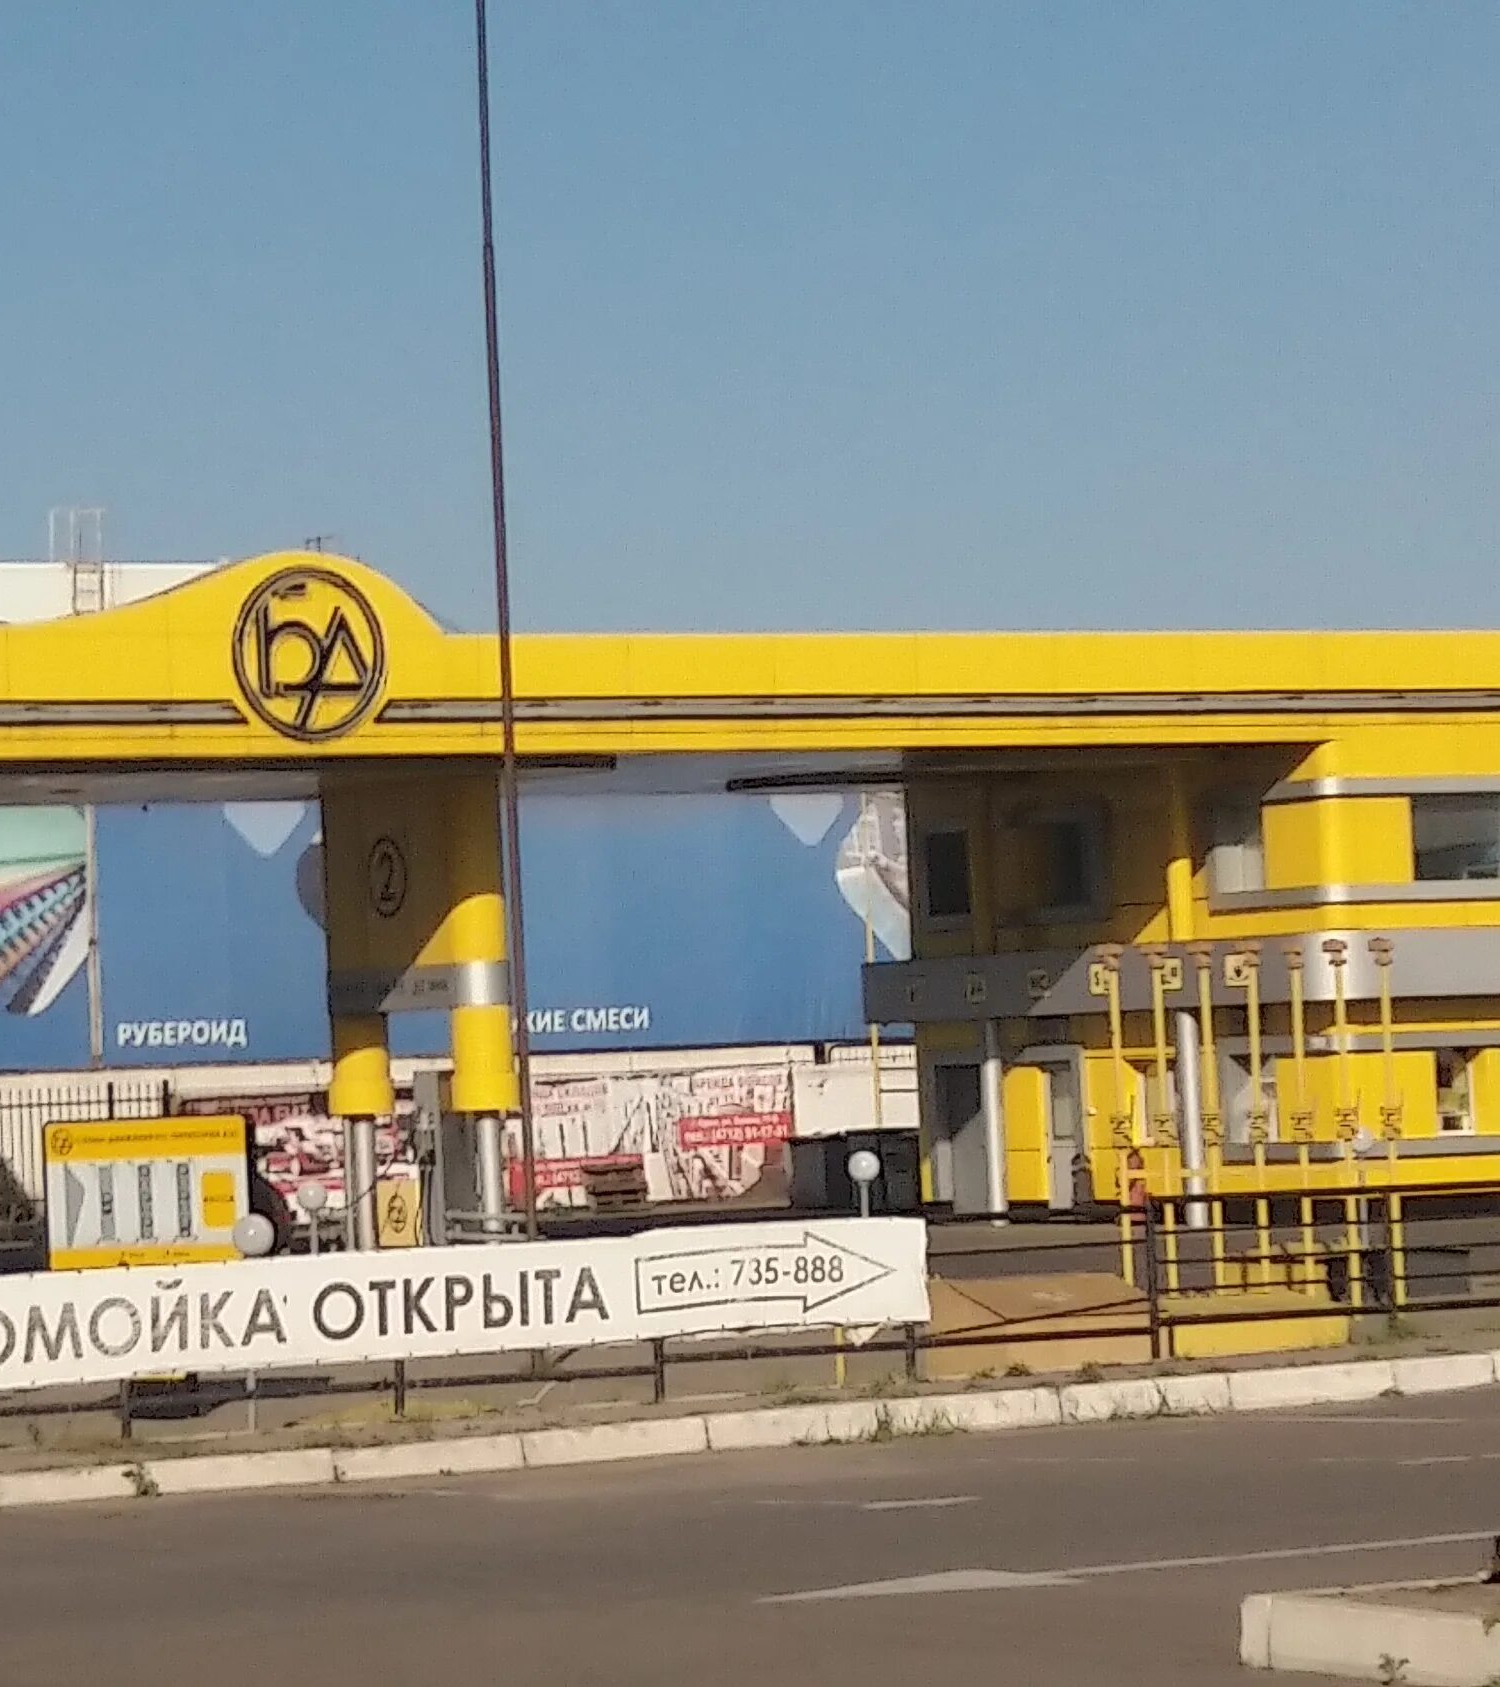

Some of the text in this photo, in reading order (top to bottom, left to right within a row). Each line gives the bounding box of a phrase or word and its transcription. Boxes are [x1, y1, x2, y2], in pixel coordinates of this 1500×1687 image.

[117, 1020, 248, 1048] РУБЕРОИД
[571, 1006, 649, 1032] СМЕСИ
[652, 1254, 844, 1296] тел.: 735-888
[313, 1265, 610, 1340] ОТКРЫТА
